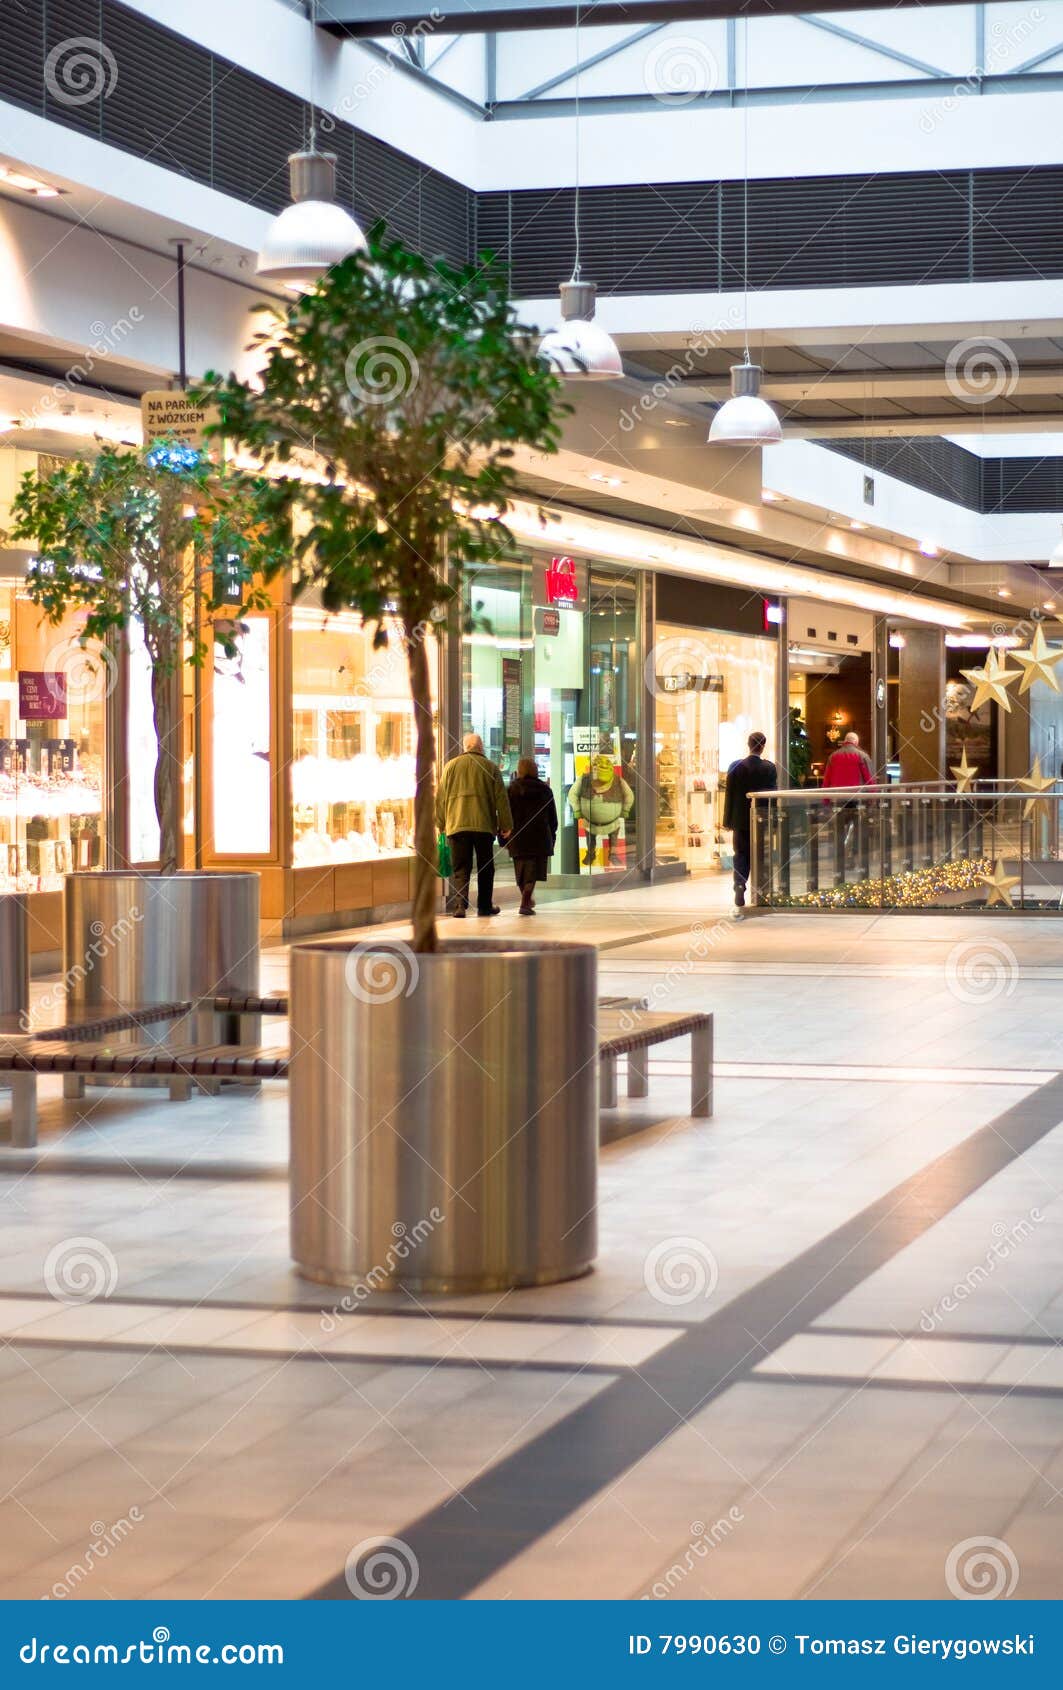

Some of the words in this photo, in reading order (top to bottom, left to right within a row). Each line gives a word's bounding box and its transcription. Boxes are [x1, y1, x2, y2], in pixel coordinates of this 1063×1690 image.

[148, 400, 163, 411] NA
[166, 399, 209, 410] PARKI
[148, 415, 155, 425] Z
